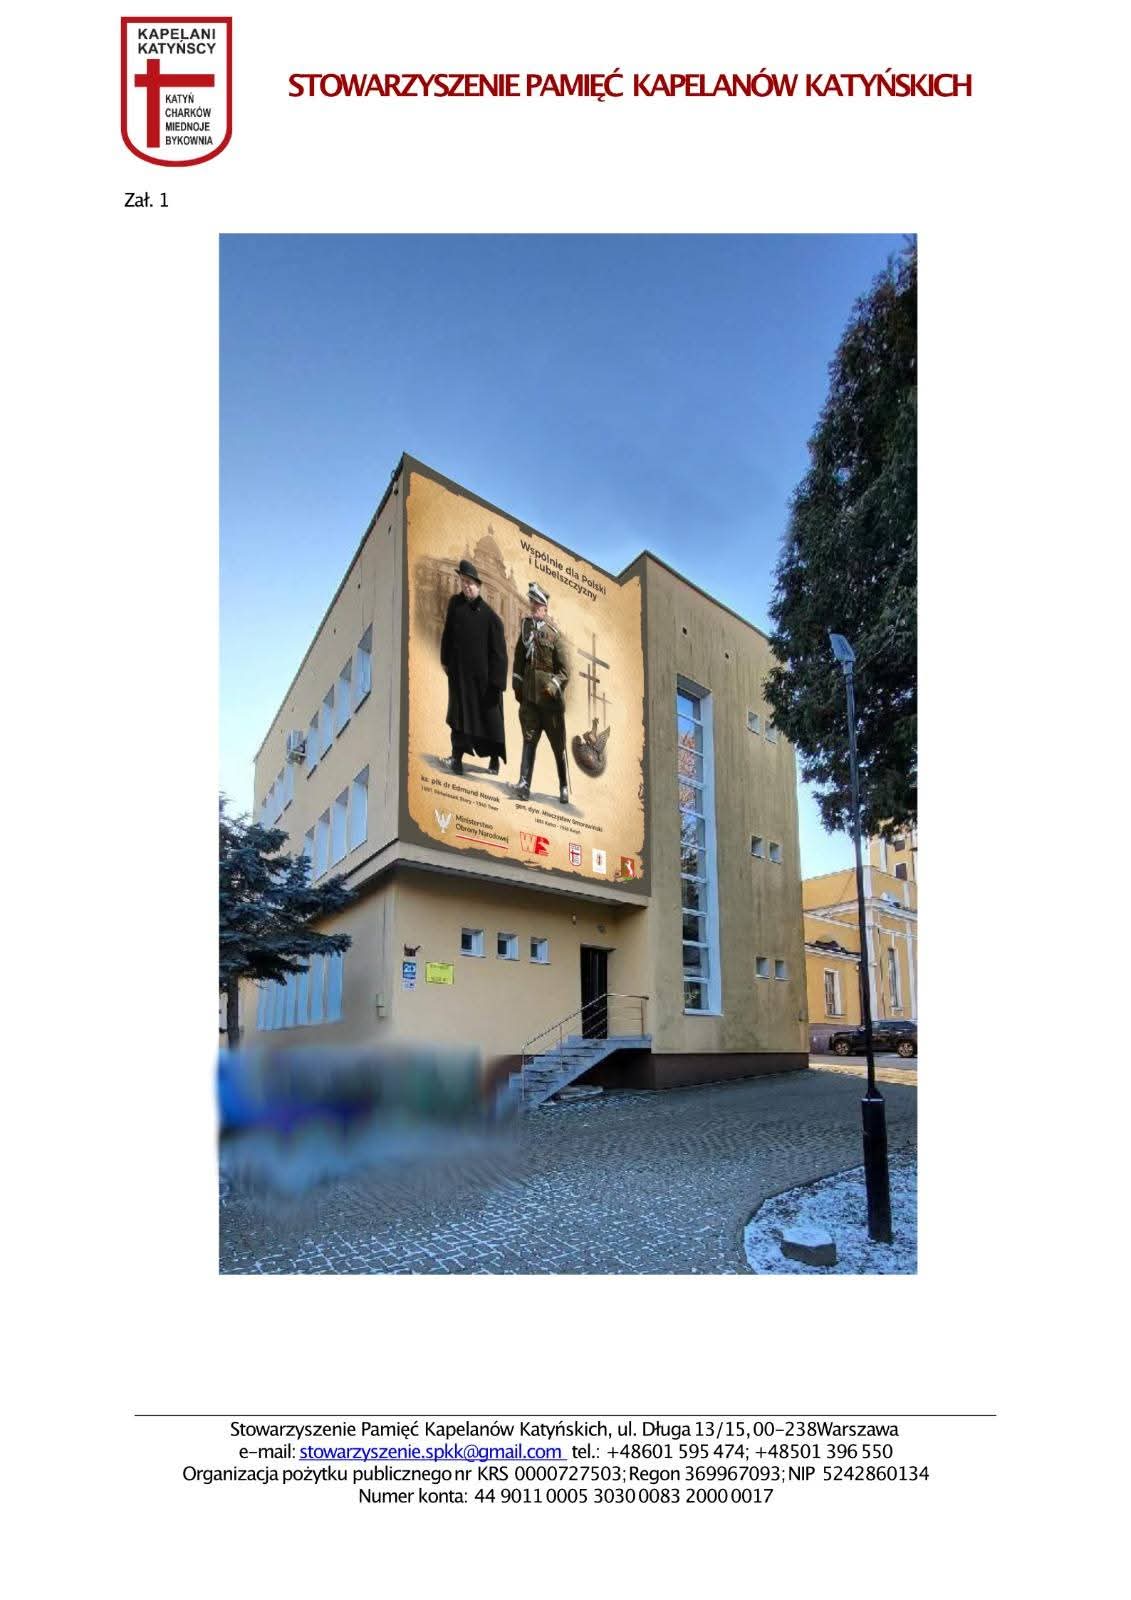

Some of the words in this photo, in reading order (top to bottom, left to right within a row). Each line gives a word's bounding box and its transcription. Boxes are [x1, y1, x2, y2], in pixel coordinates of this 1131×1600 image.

[137, 28, 216, 40] KAPELANI
[137, 40, 217, 55] KATYŃSCY
[288, 73, 521, 98] STOWARZYSZENIE
[526, 67, 624, 103] PAMIĘĆ
[633, 67, 799, 98] KAPELANÓW
[805, 67, 973, 98] KATYŃSKICH
[165, 92, 195, 104] KATYŃ
[165, 105, 212, 118] CHARKÓW
[165, 121, 211, 132] MIEDNOJE
[165, 135, 214, 146] BYKOWNIA
[124, 192, 154, 208] Zał.
[160, 192, 169, 208] 1
[520, 539, 563, 570] Wspólnie
[565, 566, 580, 580] dla
[581, 574, 607, 595] Polski
[534, 558, 598, 602] Lubelszczyzny
[451, 783, 479, 797] Edmund
[479, 792, 500, 803] Nowak
[455, 814, 493, 830] Ministerstwo
[455, 823, 478, 836] Obrony
[478, 829, 509, 844] Narodowej
[230, 1421, 357, 1441] Stowarzyszenie
[361, 1421, 419, 1440] Pamięć
[425, 1421, 515, 1441] Kapelanów
[520, 1420, 612, 1441] Katyńskich,
[617, 1420, 637, 1437] ul.
[642, 1420, 692, 1441] Długa
[238, 1443, 296, 1459] e-mail:
[299, 1443, 563, 1463] stowarzyszenie.spkk@gmail.com
[571, 1443, 600, 1459] tel.:
[607, 1443, 673, 1459] +48601
[679, 1443, 709, 1459] 595
[713, 1443, 749, 1461] 474;
[755, 1443, 821, 1459] +48501
[826, 1443, 858, 1459] 396
[862, 1443, 894, 1459] 550
[182, 1466, 279, 1484] Organizacja
[282, 1465, 348, 1484] pożytku
[353, 1465, 453, 1484] publicznego
[454, 1469, 473, 1481] nr
[477, 1466, 509, 1481] KRS
[514, 1466, 626, 1484] 0000727503;
[629, 1466, 681, 1484] Regon
[685, 1466, 785, 1484] 369967093;
[788, 1466, 816, 1481] NIP
[823, 1466, 930, 1481] 5242860134
[359, 1488, 415, 1504] Numer
[418, 1487, 468, 1504] konta:
[474, 1488, 496, 1504] 44
[500, 1488, 543, 1504] 9011
[545, 1488, 588, 1504] 0005
[593, 1488, 636, 1504] 3030
[638, 1488, 681, 1504] 0083
[685, 1488, 729, 1504] 2000
[730, 1488, 774, 1504] 0017
